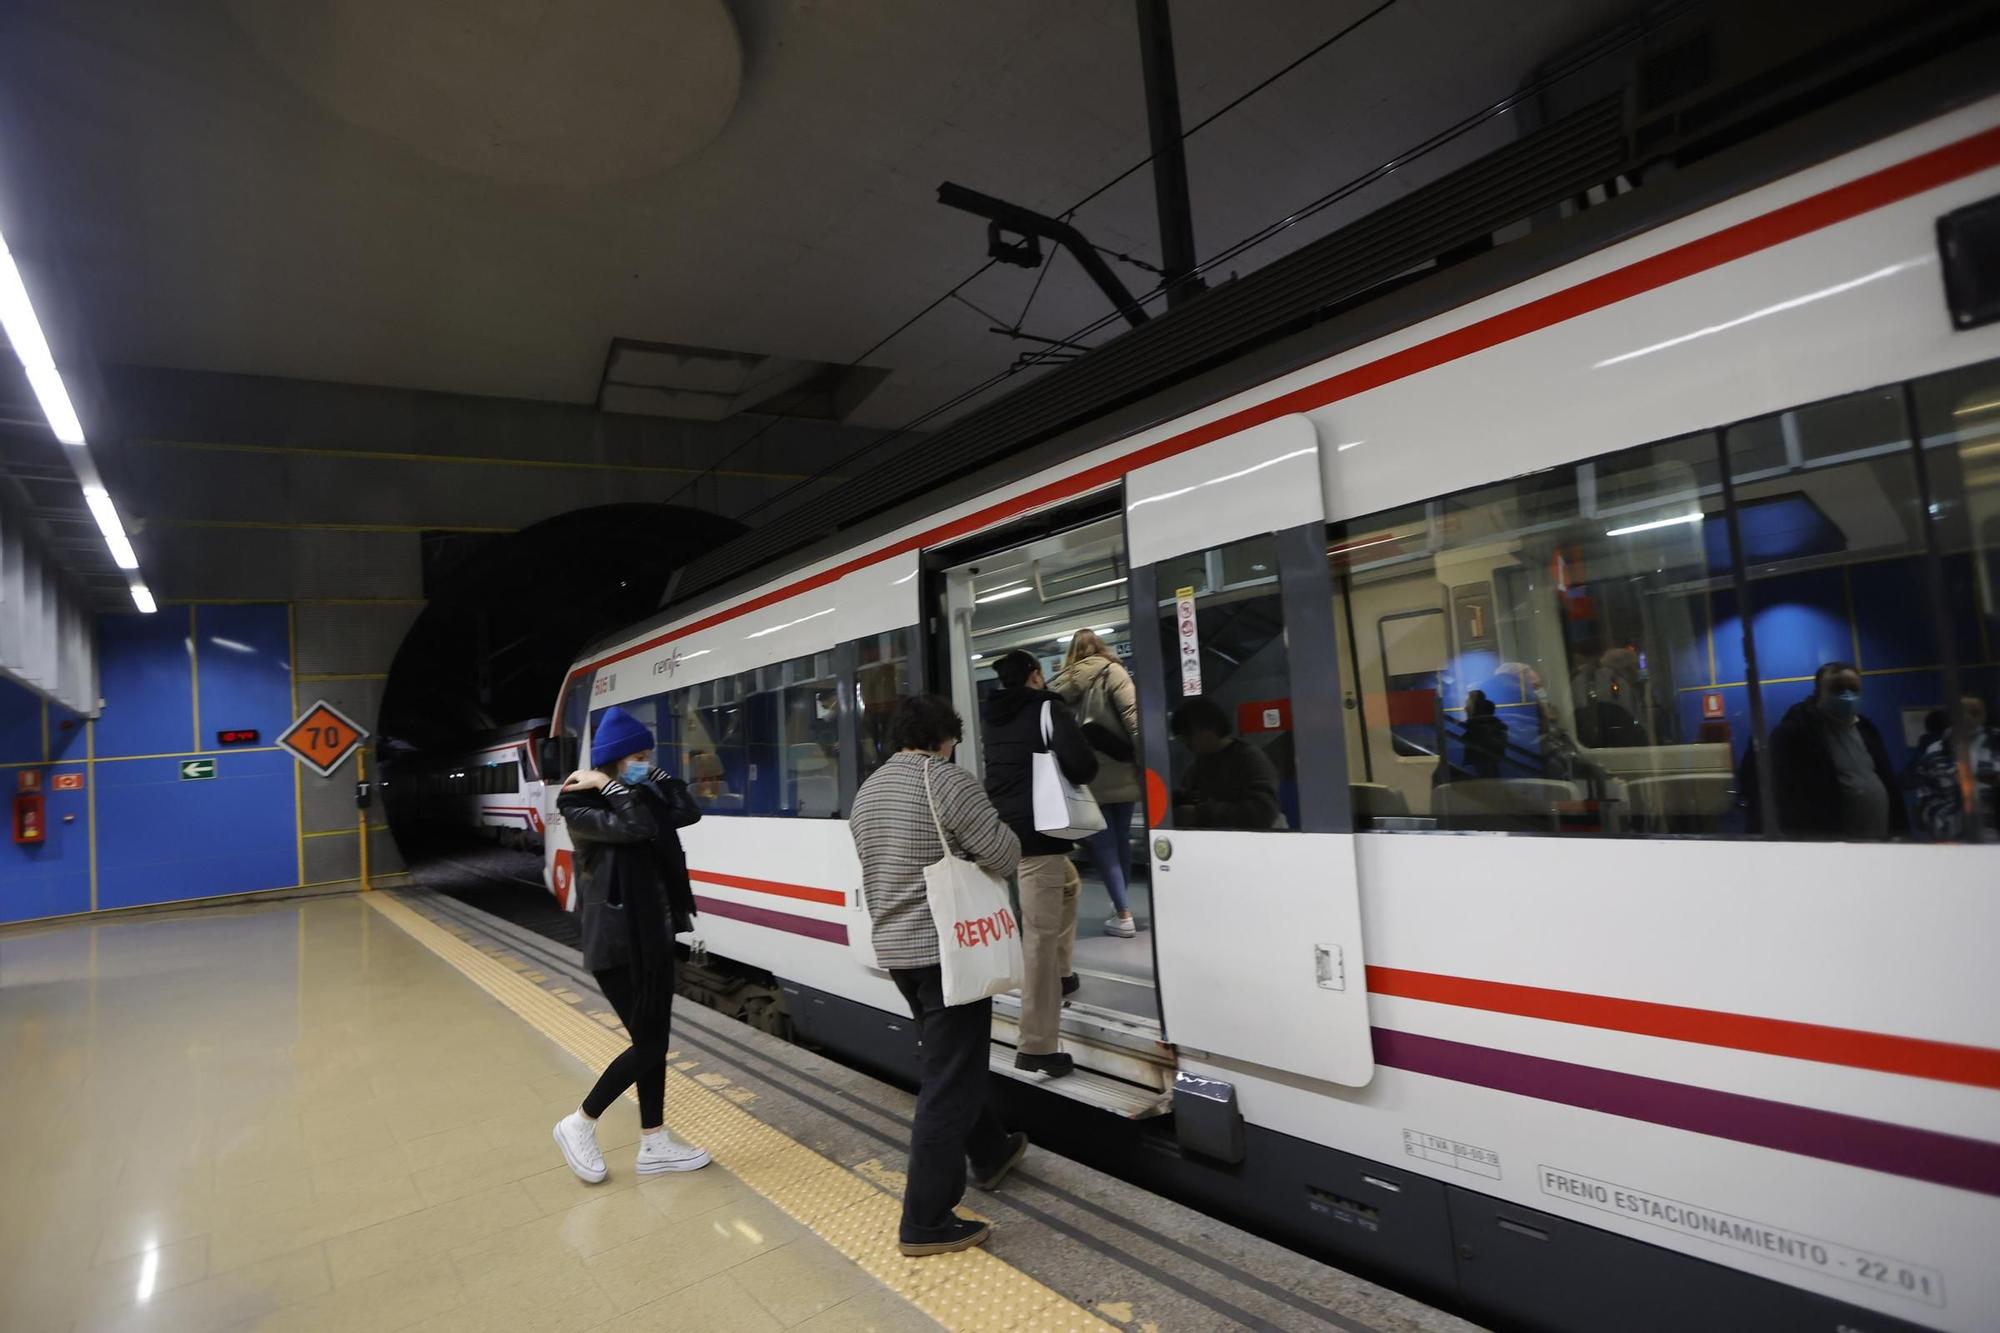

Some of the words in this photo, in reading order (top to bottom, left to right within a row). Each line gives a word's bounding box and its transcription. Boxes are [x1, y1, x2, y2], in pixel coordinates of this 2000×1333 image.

[305, 725, 340, 751] 70
[1545, 1171, 1608, 1204] FRENO
[1614, 1190, 1829, 1266] ESTACIONAMIENTO
